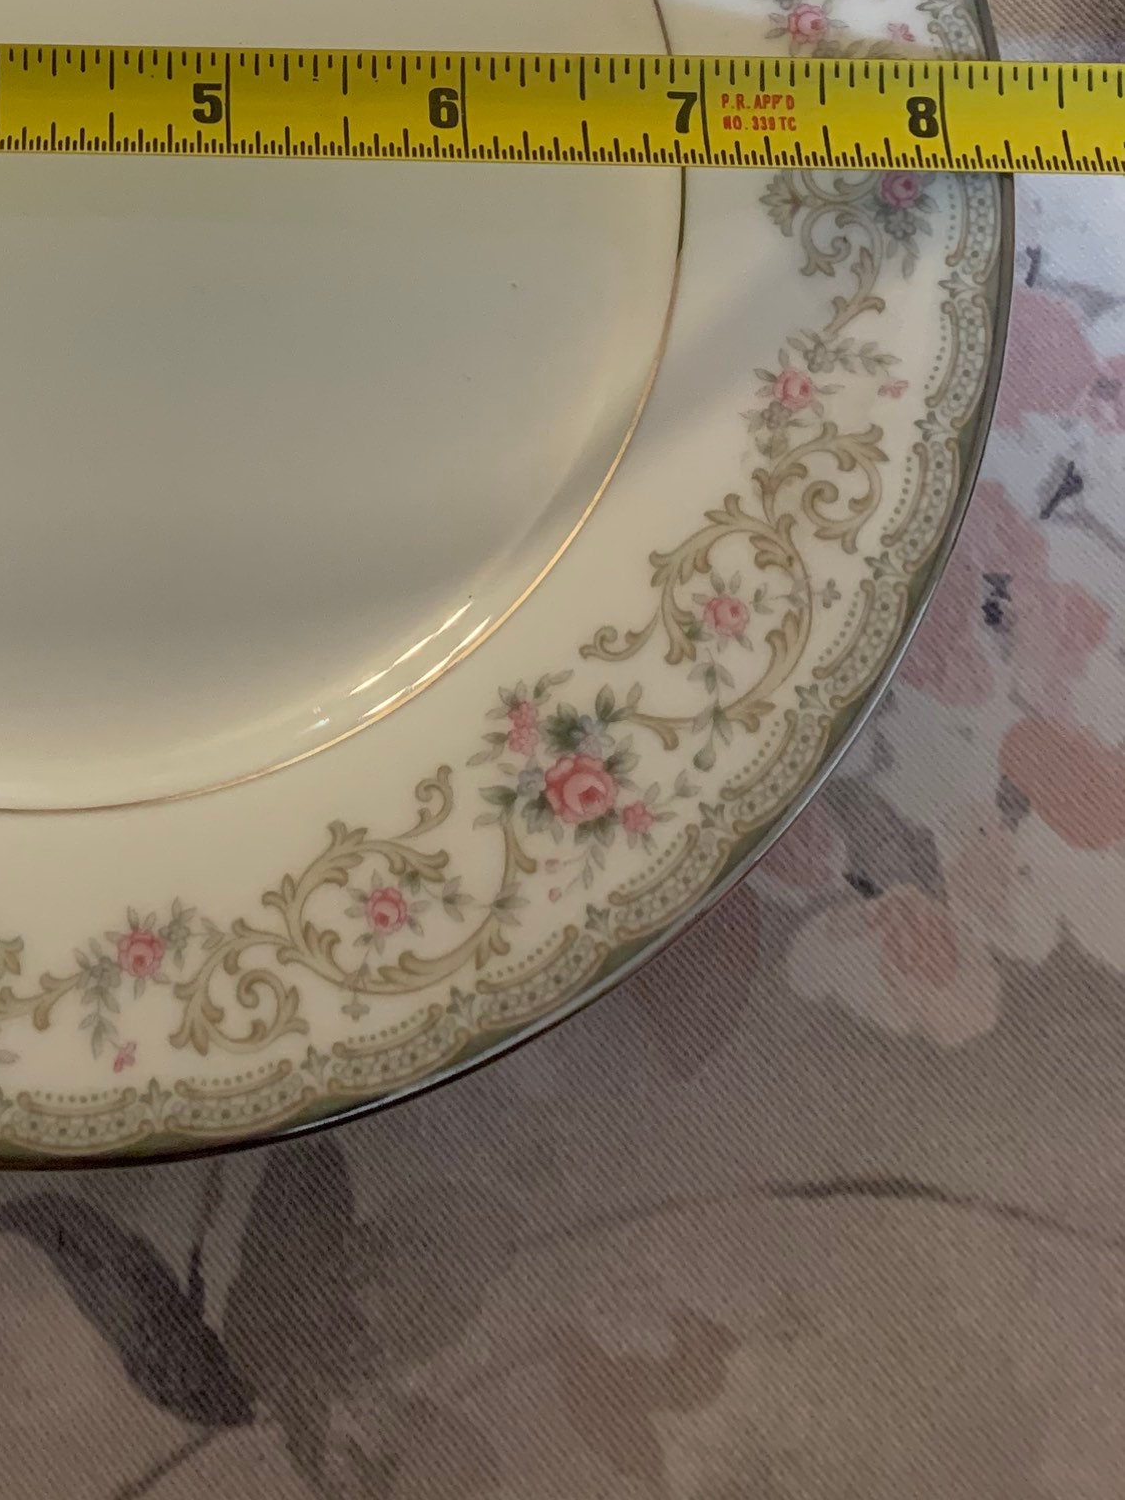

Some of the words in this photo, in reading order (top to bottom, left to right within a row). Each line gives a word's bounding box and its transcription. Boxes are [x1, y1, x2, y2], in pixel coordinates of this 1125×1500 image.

[192, 83, 224, 124] 5
[428, 87, 459, 129] 6
[667, 91, 698, 134] 7
[906, 96, 939, 138] 8
